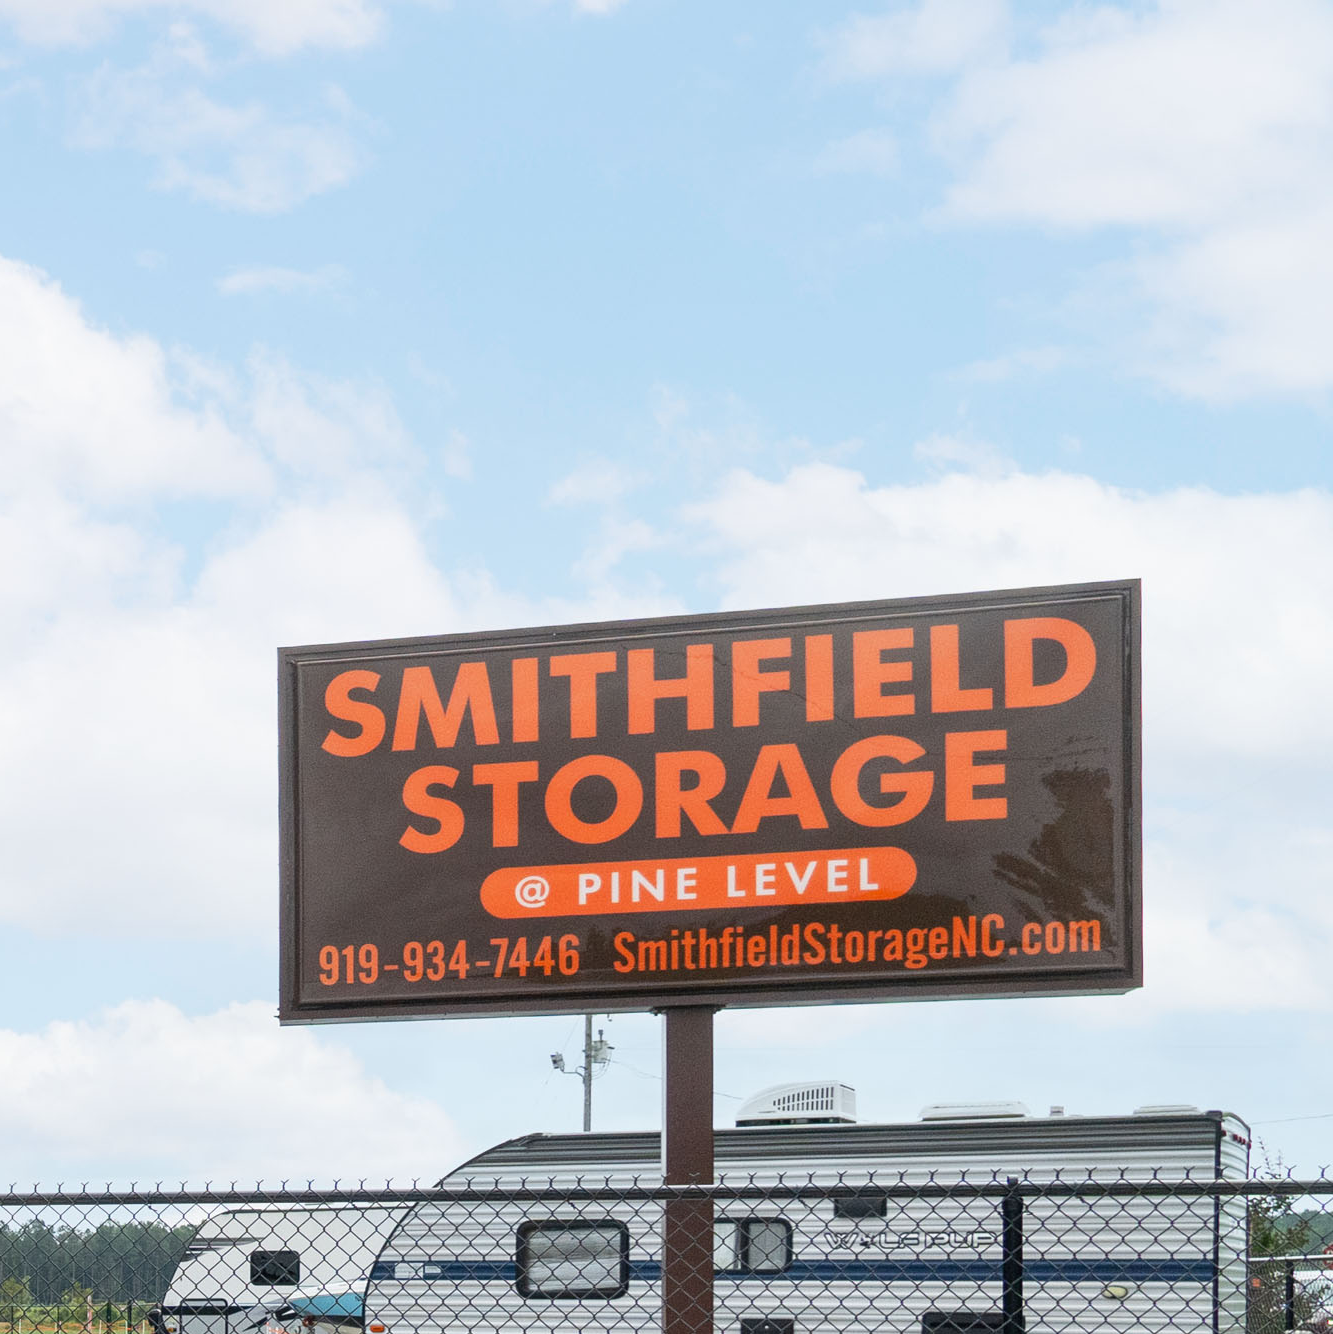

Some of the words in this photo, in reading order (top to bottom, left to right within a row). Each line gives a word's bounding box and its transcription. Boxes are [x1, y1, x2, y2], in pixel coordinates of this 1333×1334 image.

[321, 617, 1097, 758] SMITHFIELD
[399, 730, 1008, 855] STORAGE
[514, 875, 550, 909] @
[578, 868, 697, 906] PINE
[728, 858, 879, 898] LEVEL
[318, 933, 580, 986] 919-934-7446
[613, 913, 1102, 973] SmithfieldStorageNC.com
[925, 1231, 997, 1249] PUP
